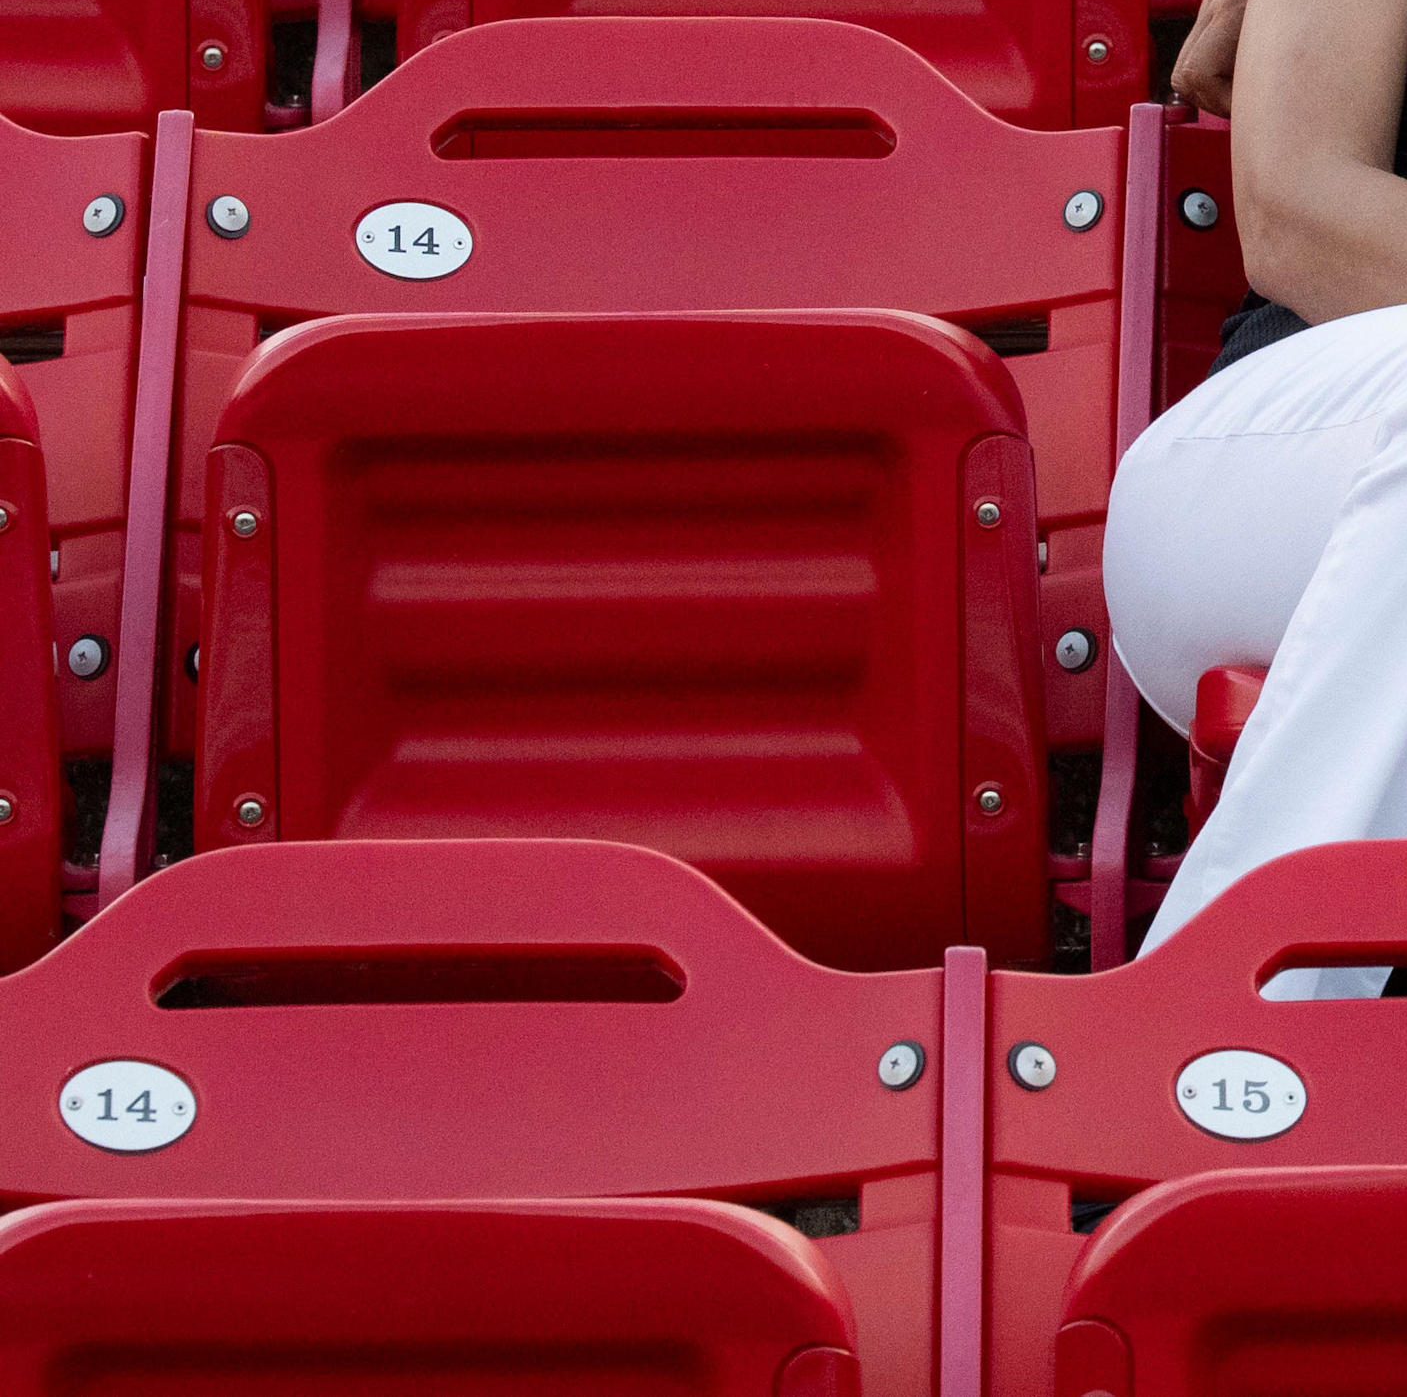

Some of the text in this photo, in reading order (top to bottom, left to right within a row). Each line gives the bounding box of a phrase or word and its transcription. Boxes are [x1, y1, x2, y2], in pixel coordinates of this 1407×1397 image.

[387, 224, 441, 256] 14
[96, 1088, 158, 1123] 14
[1211, 1078, 1272, 1114] 15
